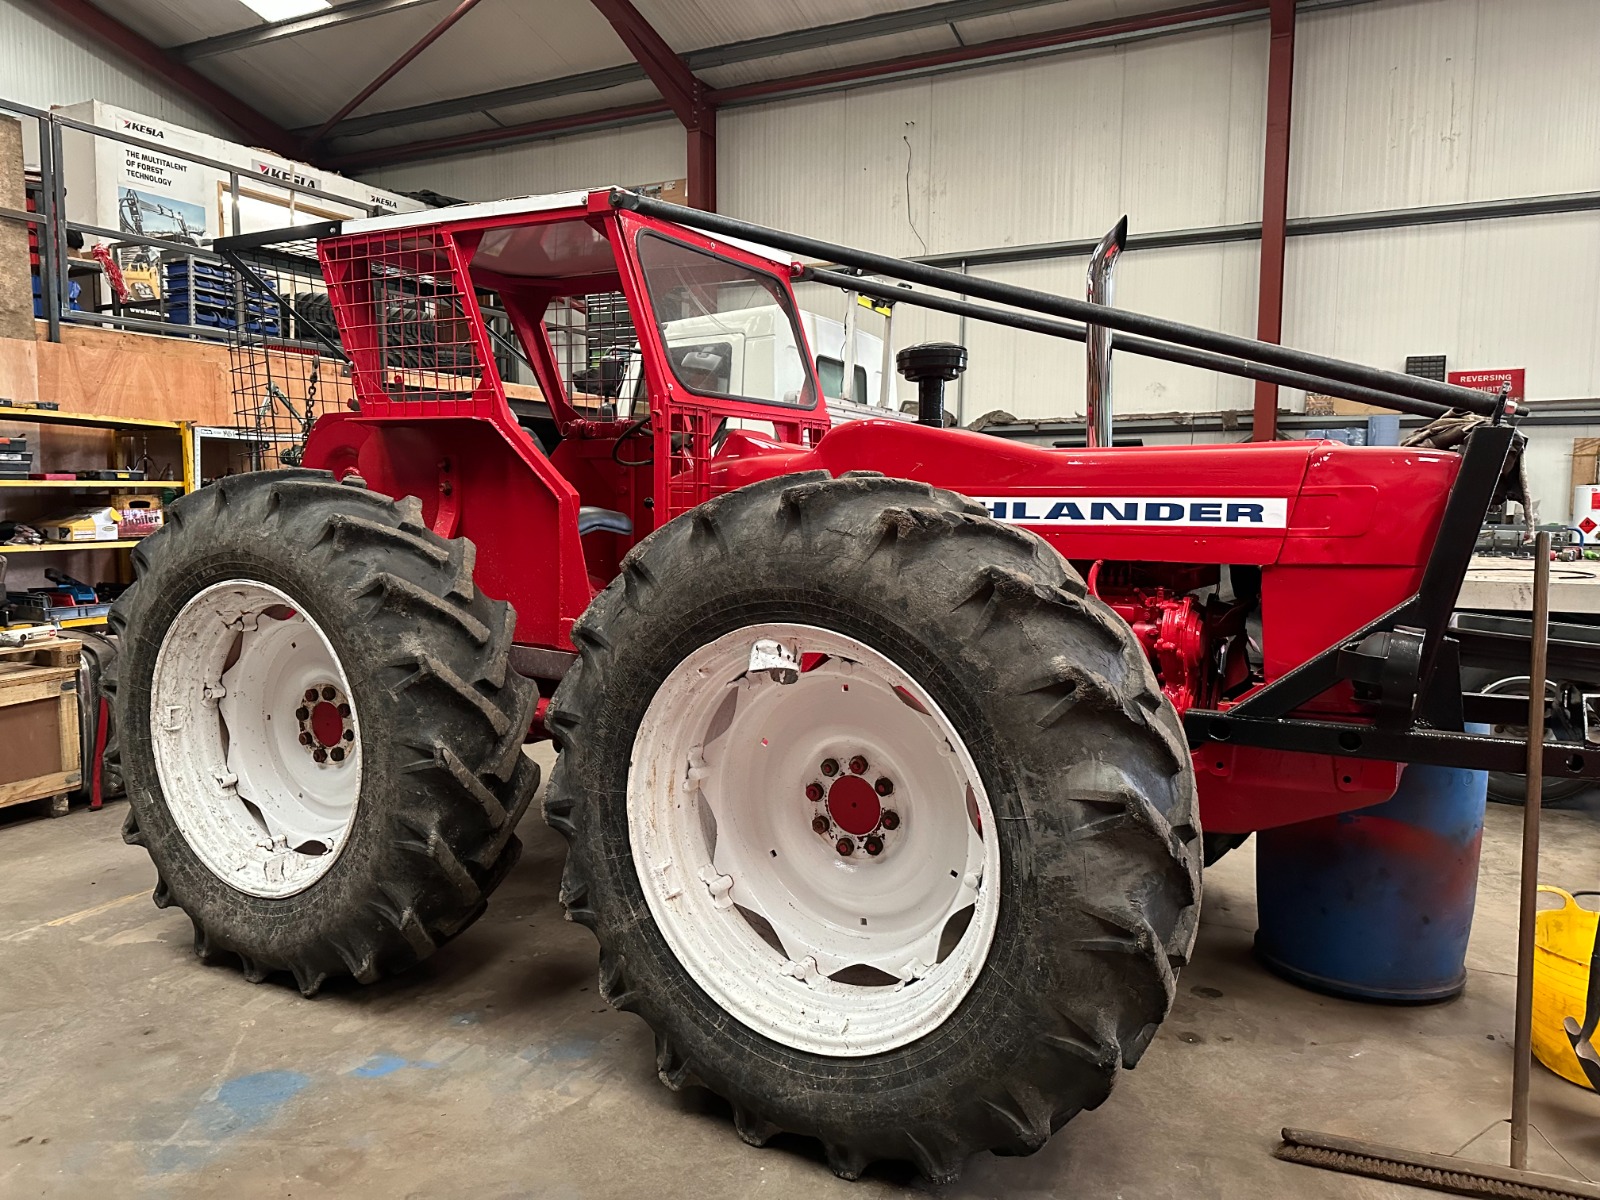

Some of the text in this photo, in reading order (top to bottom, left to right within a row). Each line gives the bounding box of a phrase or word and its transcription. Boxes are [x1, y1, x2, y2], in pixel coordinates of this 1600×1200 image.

[131, 122, 164, 139] KESLA
[125, 149, 187, 172] THE MULTITALENT
[125, 159, 164, 175] OF FOREST
[125, 169, 172, 186] TECHNOLOGY
[375, 197, 398, 208] KESLA
[1460, 373, 1512, 383] REVERSING
